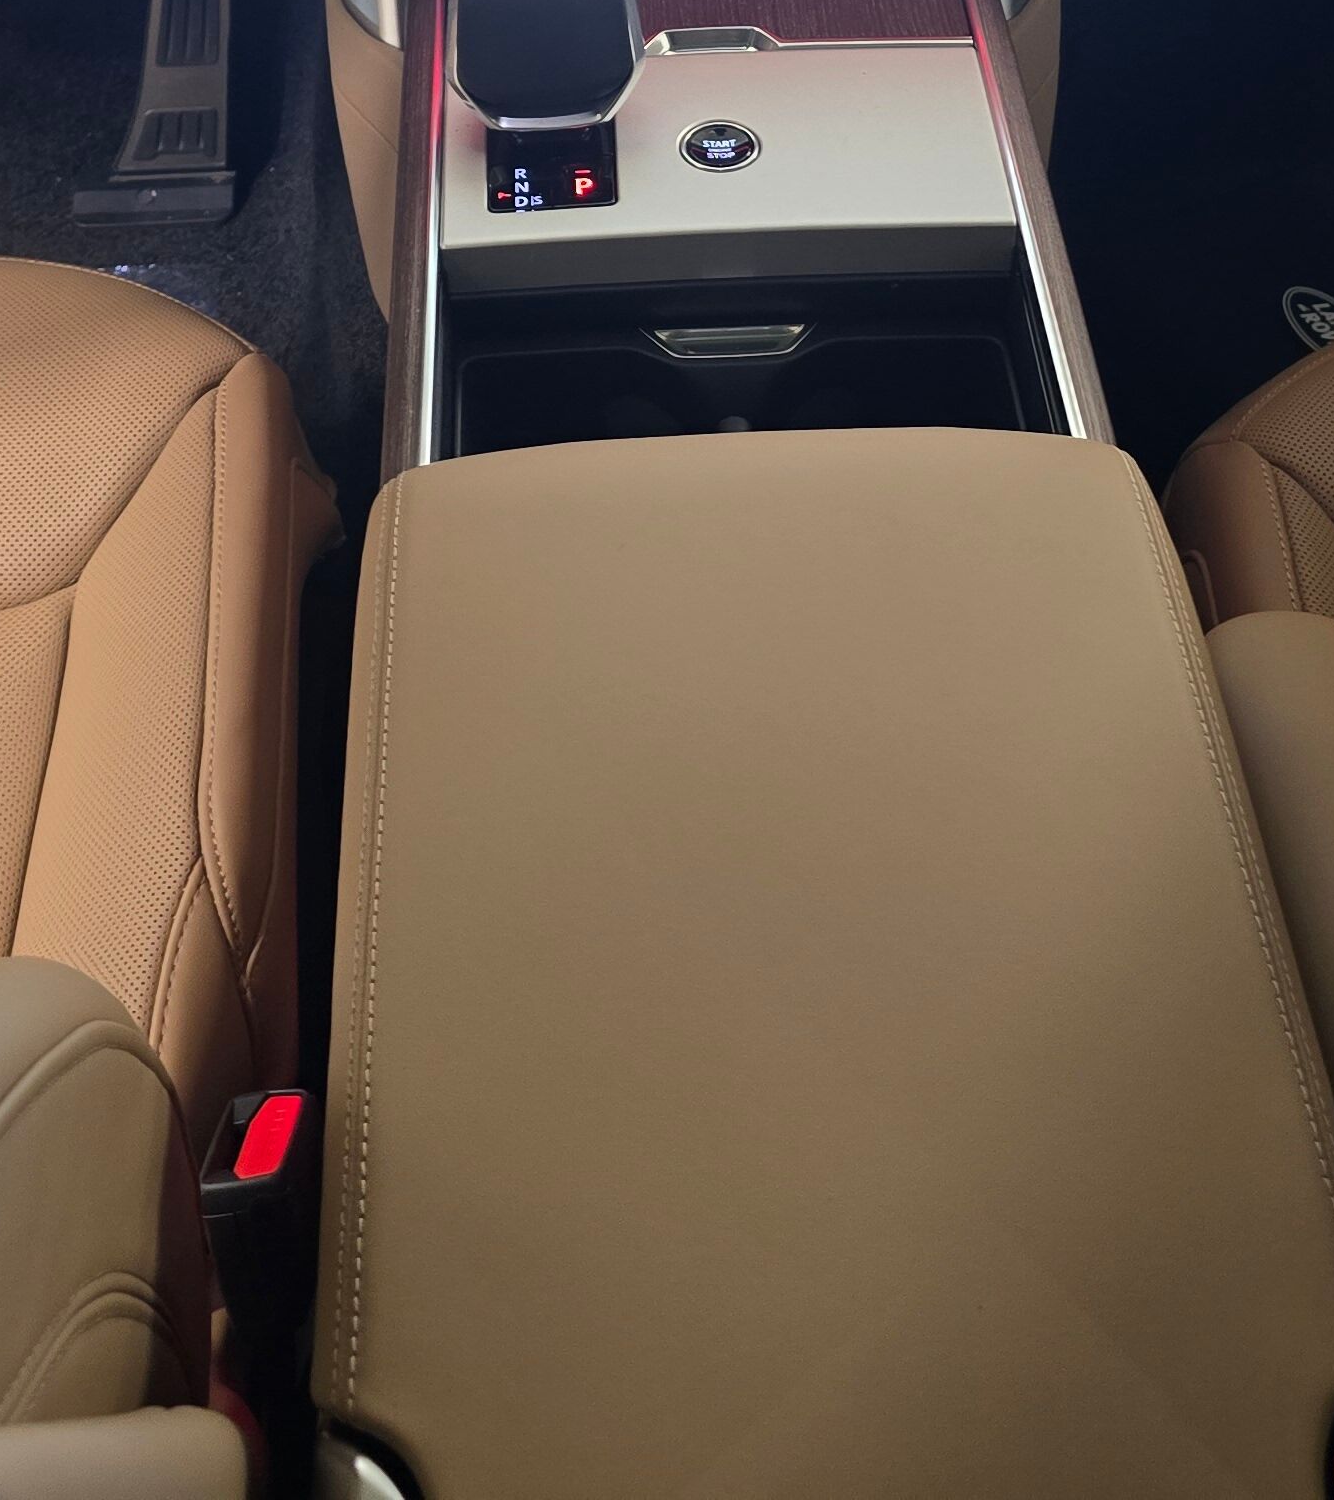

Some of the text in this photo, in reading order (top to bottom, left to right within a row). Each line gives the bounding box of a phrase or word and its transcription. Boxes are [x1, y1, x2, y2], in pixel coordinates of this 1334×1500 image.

[702, 138, 737, 148] START
[707, 151, 736, 159] STOP
[514, 168, 527, 180] R
[514, 182, 530, 194] N
[574, 177, 594, 196] P
[514, 196, 529, 208] D
